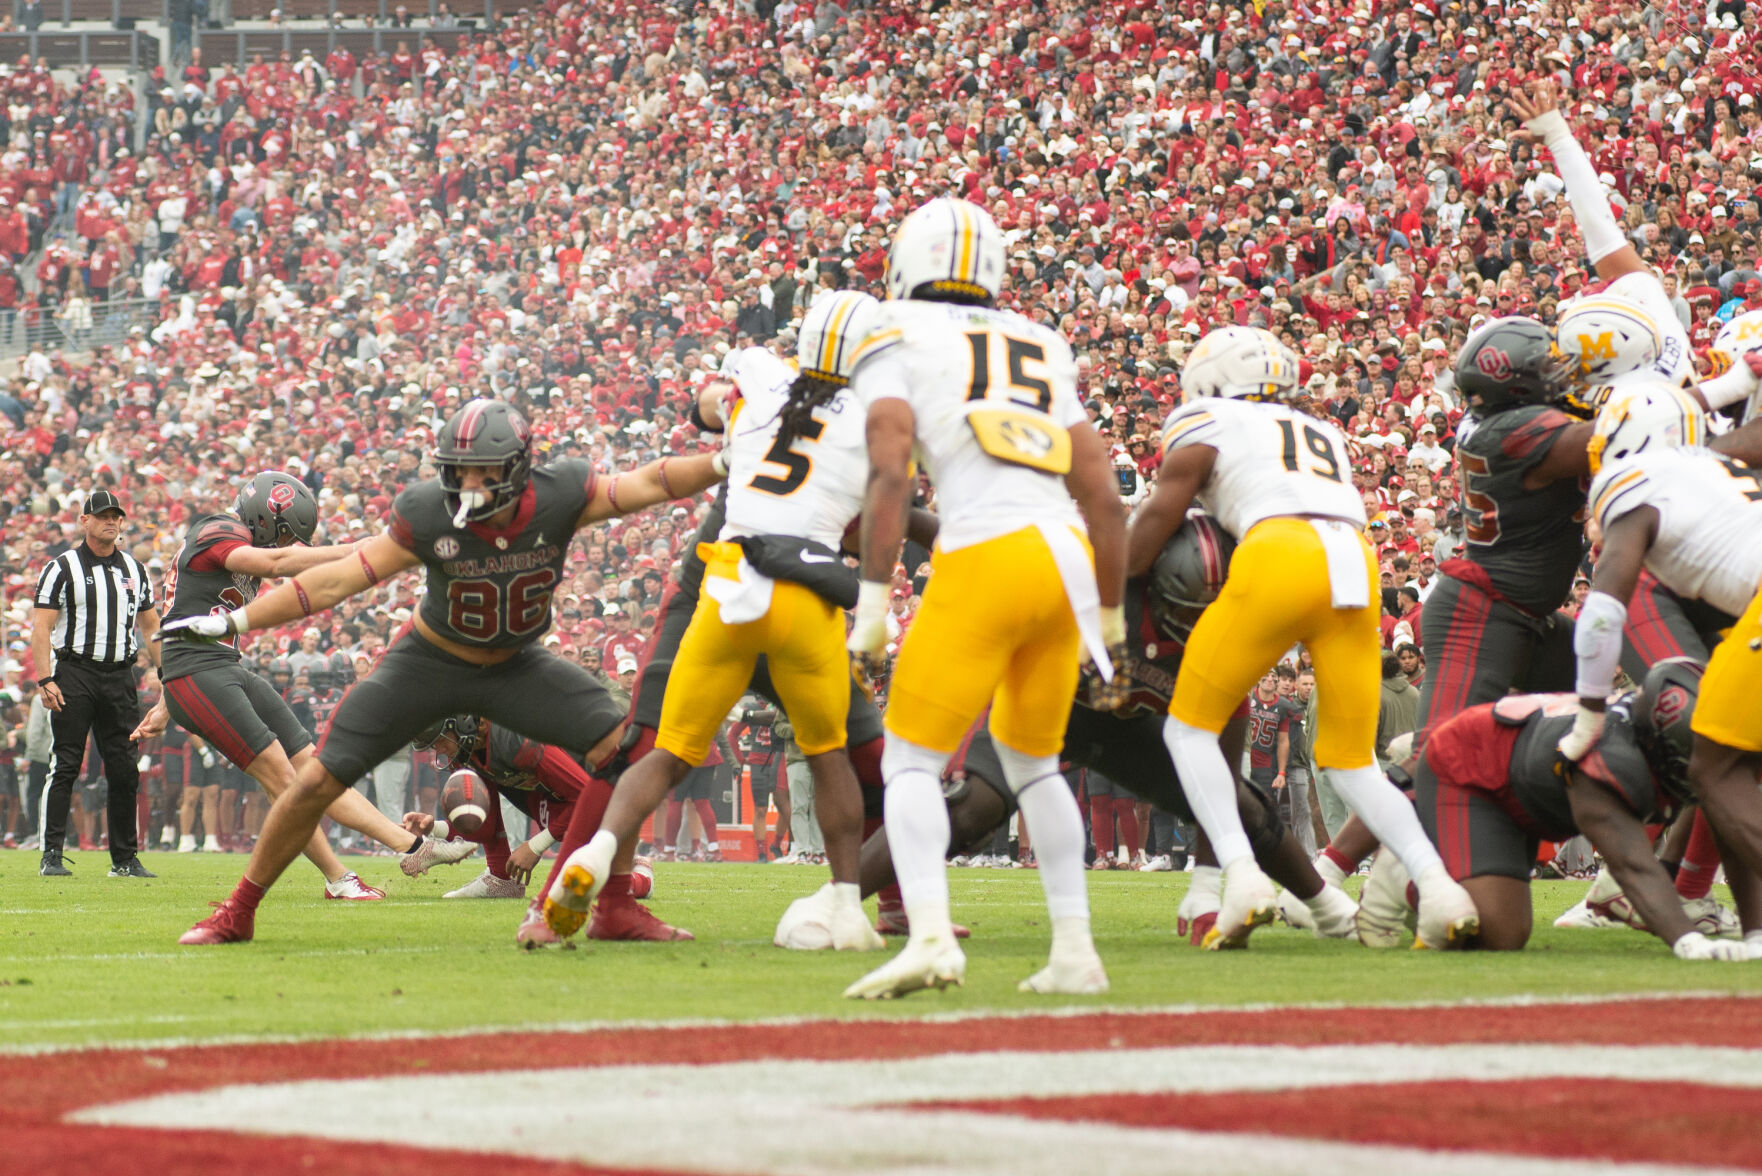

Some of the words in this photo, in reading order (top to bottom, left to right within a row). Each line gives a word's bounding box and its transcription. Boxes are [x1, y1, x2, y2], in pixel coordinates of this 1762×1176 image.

[1476, 346, 1513, 383] OU
[1577, 331, 1618, 361] M
[963, 331, 1053, 414] 15
[748, 417, 827, 497] 5
[1275, 419, 1343, 483] 19
[267, 483, 296, 514] OU
[443, 545, 559, 577] OKLAHOMA
[86, 576, 94, 585] S
[127, 602, 135, 616] C
[447, 566, 556, 642] 86
[1652, 686, 1688, 732] OU
